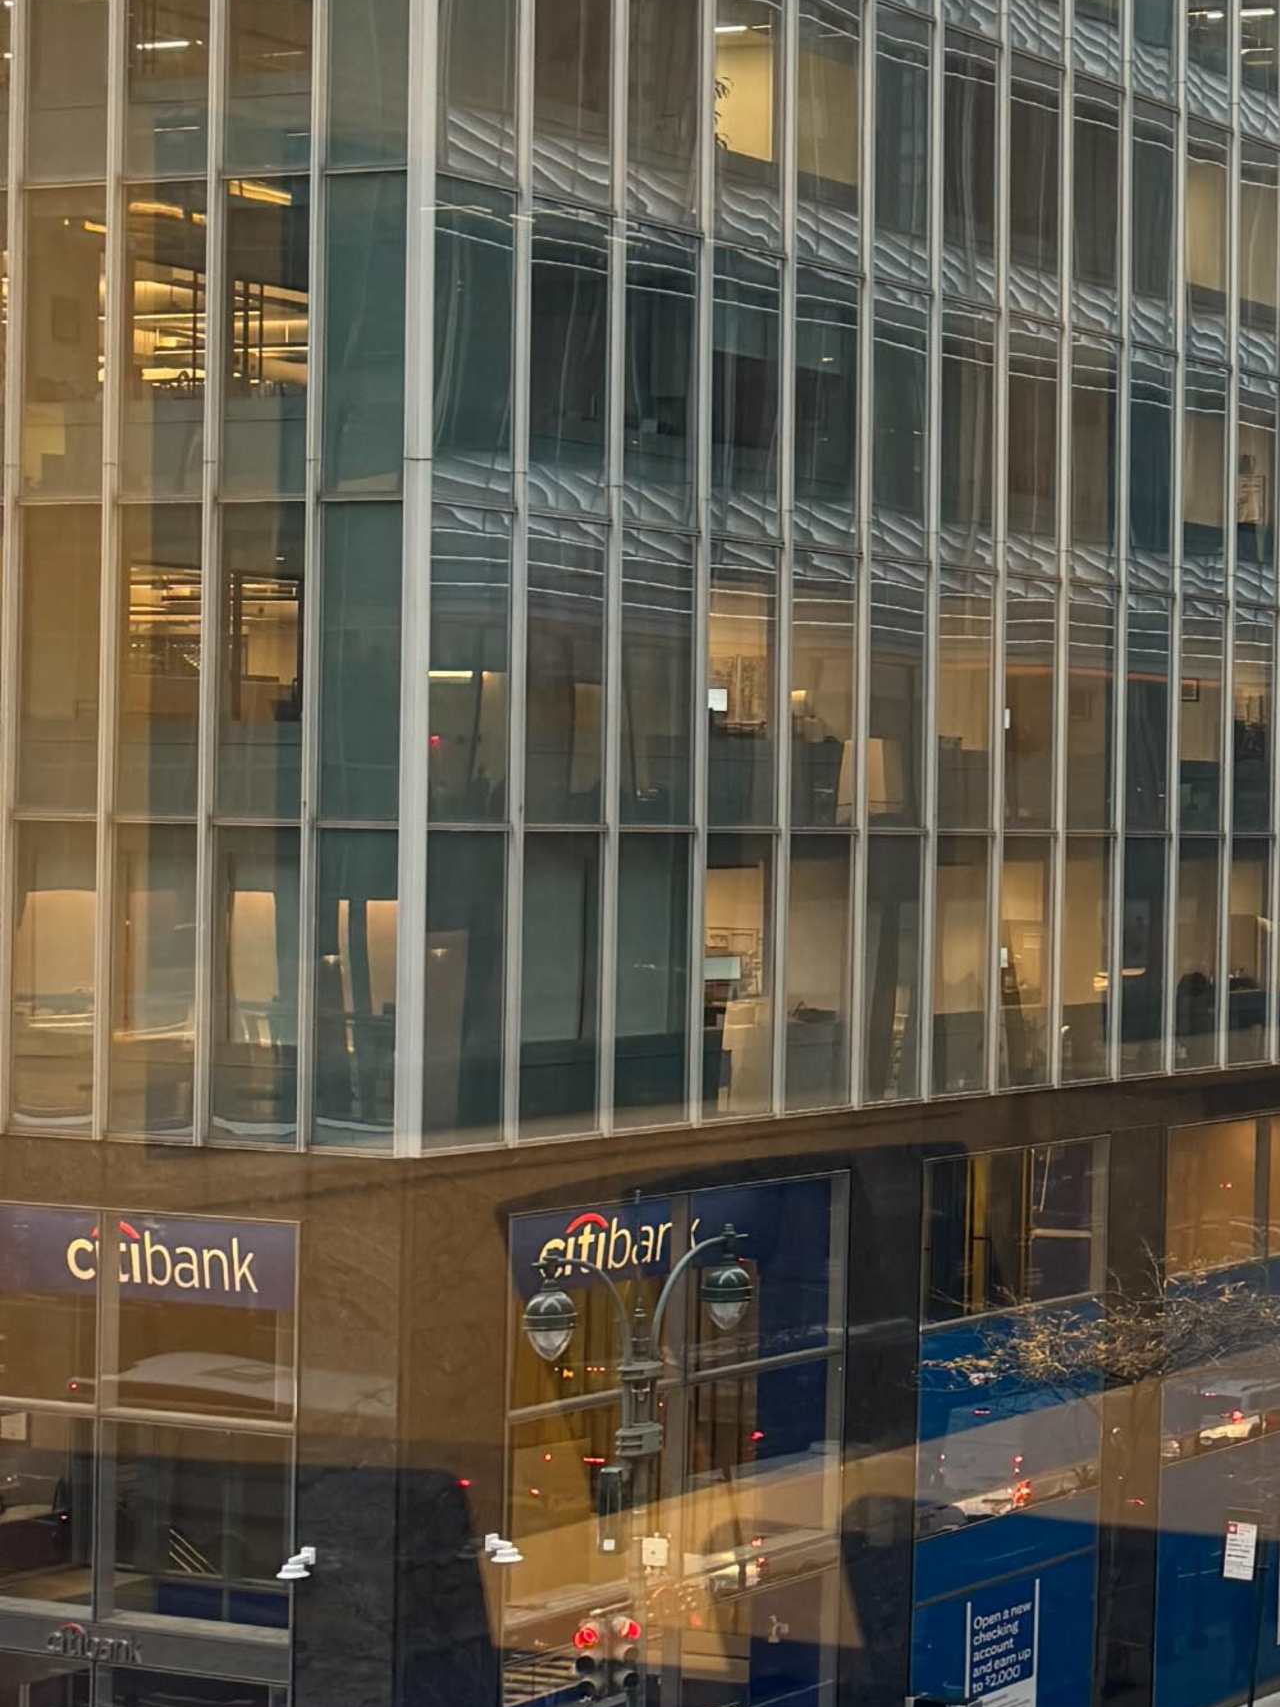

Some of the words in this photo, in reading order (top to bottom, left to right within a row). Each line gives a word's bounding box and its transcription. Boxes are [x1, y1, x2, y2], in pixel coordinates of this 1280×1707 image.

[66, 1223, 258, 1293] cibank
[973, 1610, 1001, 1630] Open
[1002, 1608, 1010, 1620] a
[1010, 1601, 1032, 1617] new
[973, 1620, 1019, 1645] checking
[972, 1660, 993, 1678] and
[993, 1654, 1016, 1672] earn
[1017, 1648, 1032, 1662] up
[973, 1638, 1014, 1663] account
[972, 1681, 984, 1694] to
[985, 1665, 1021, 1688] $2,000
